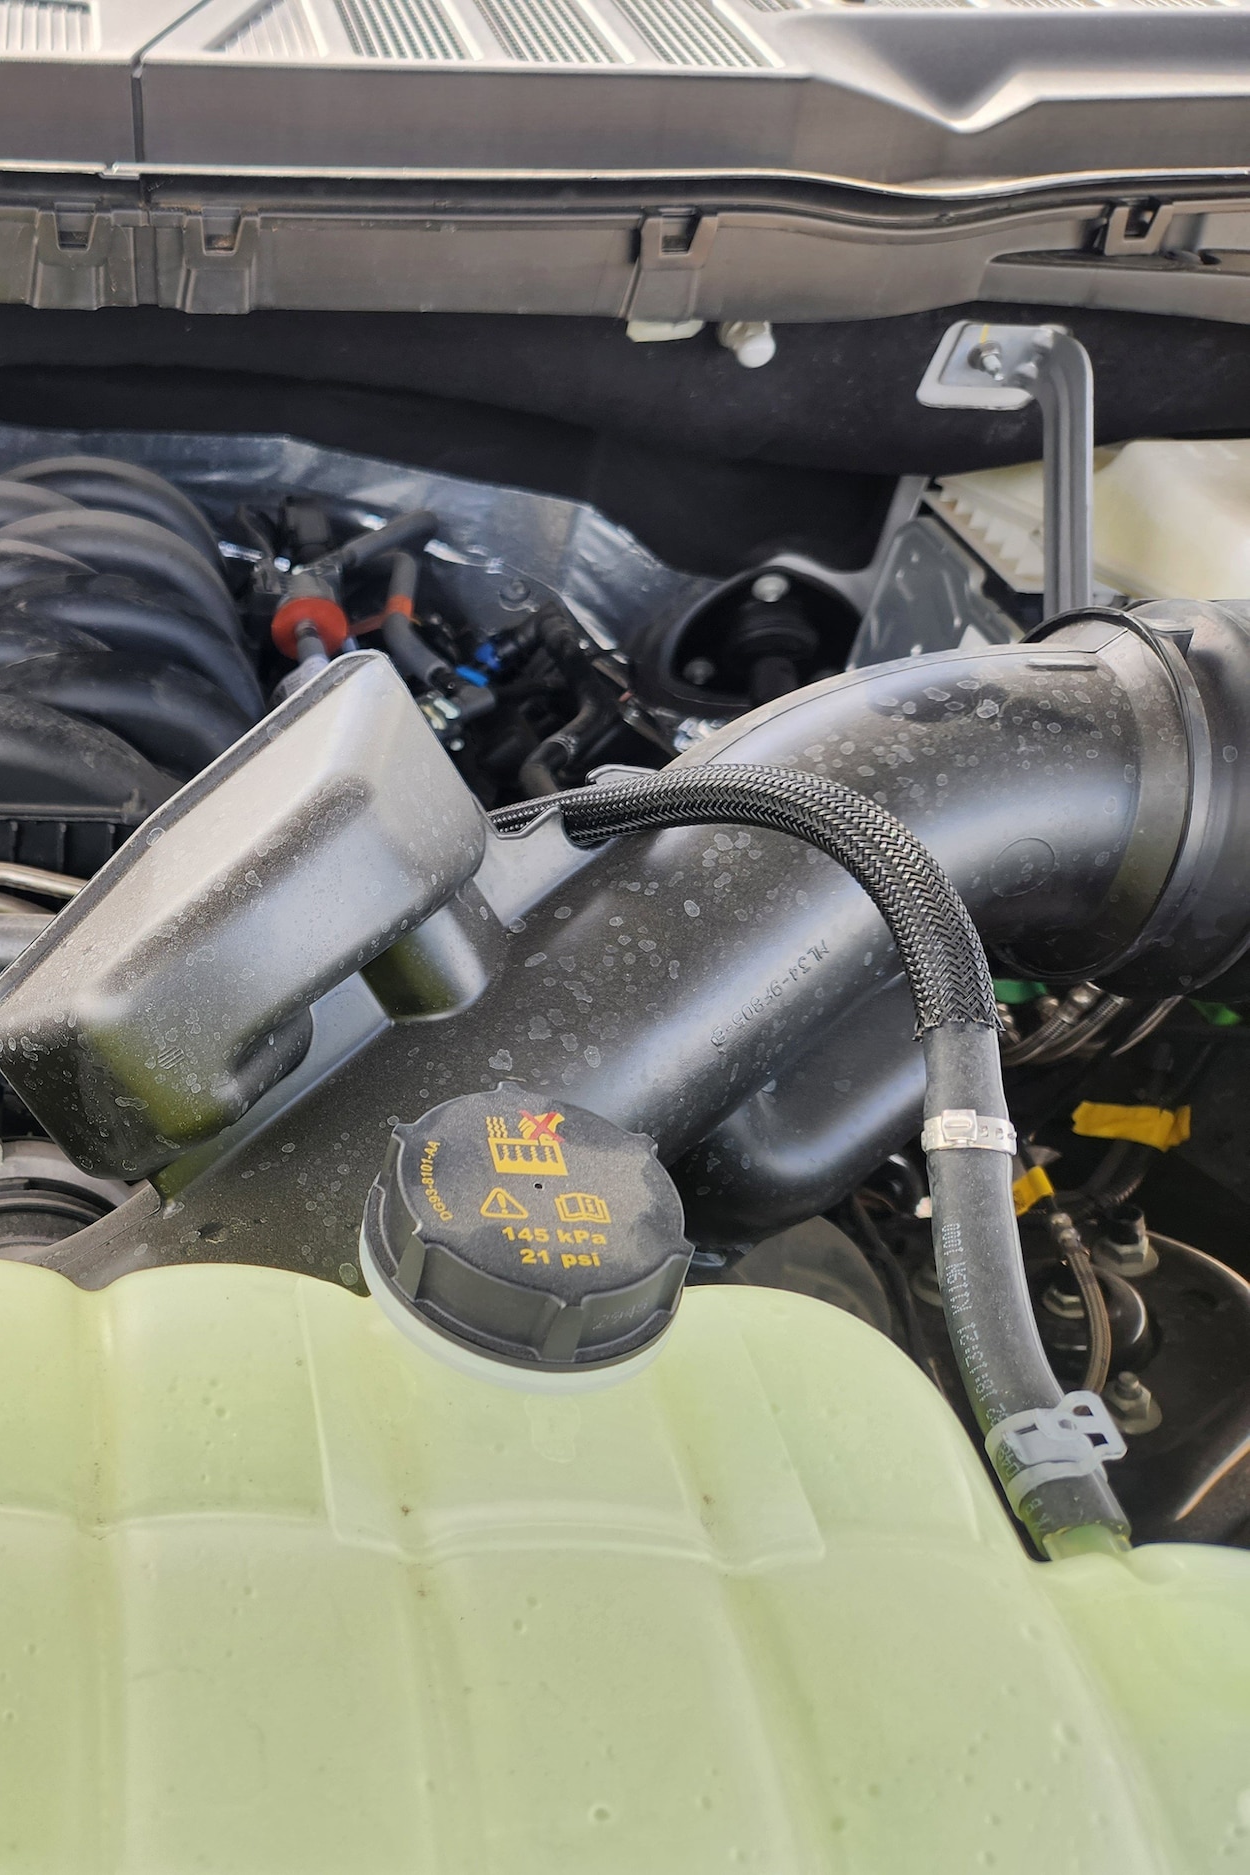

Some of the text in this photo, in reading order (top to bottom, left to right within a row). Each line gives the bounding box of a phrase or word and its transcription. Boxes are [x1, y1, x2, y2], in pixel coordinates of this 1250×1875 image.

[419, 1140, 454, 1223] DG93-8101-AA
[501, 1226, 608, 1246] 145 kPa
[940, 1222, 964, 1256] 1000
[519, 1247, 601, 1270] 21 psi
[956, 1321, 998, 1402] 18:13:21
